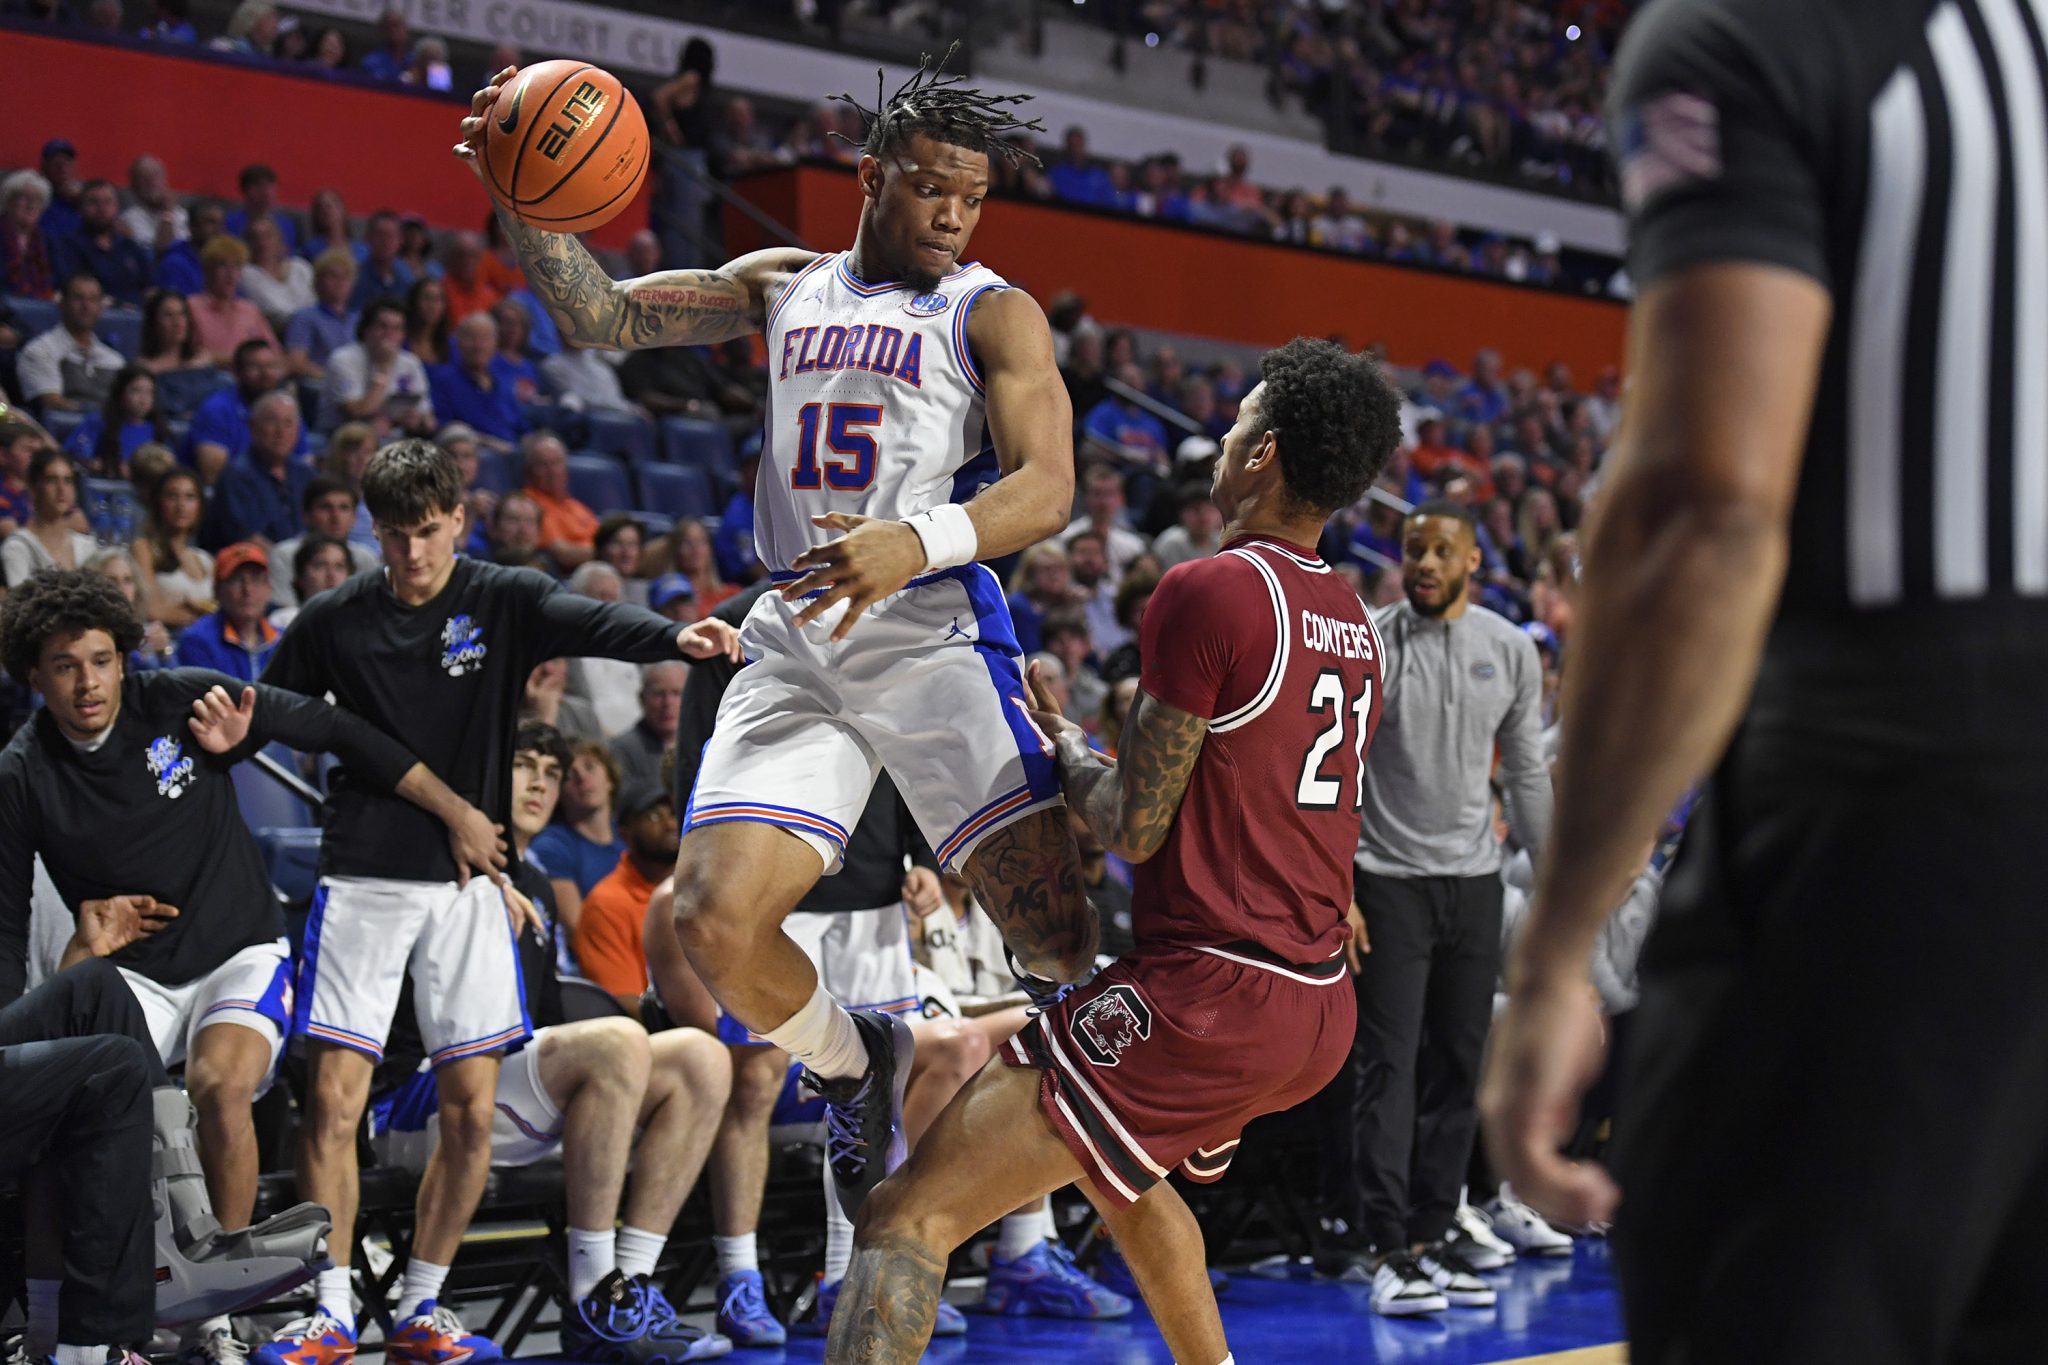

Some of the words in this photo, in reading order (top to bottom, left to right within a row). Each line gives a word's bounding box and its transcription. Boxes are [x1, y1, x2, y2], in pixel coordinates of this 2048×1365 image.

[484, 3, 610, 54] COURT
[535, 81, 603, 160] ELITE
[630, 287, 685, 304] DETERMINED
[686, 289, 697, 306] TO
[780, 323, 923, 389] FLORIDA
[791, 402, 884, 491] 15
[1301, 609, 1374, 661] CONYERS
[1295, 667, 1374, 813] 21
